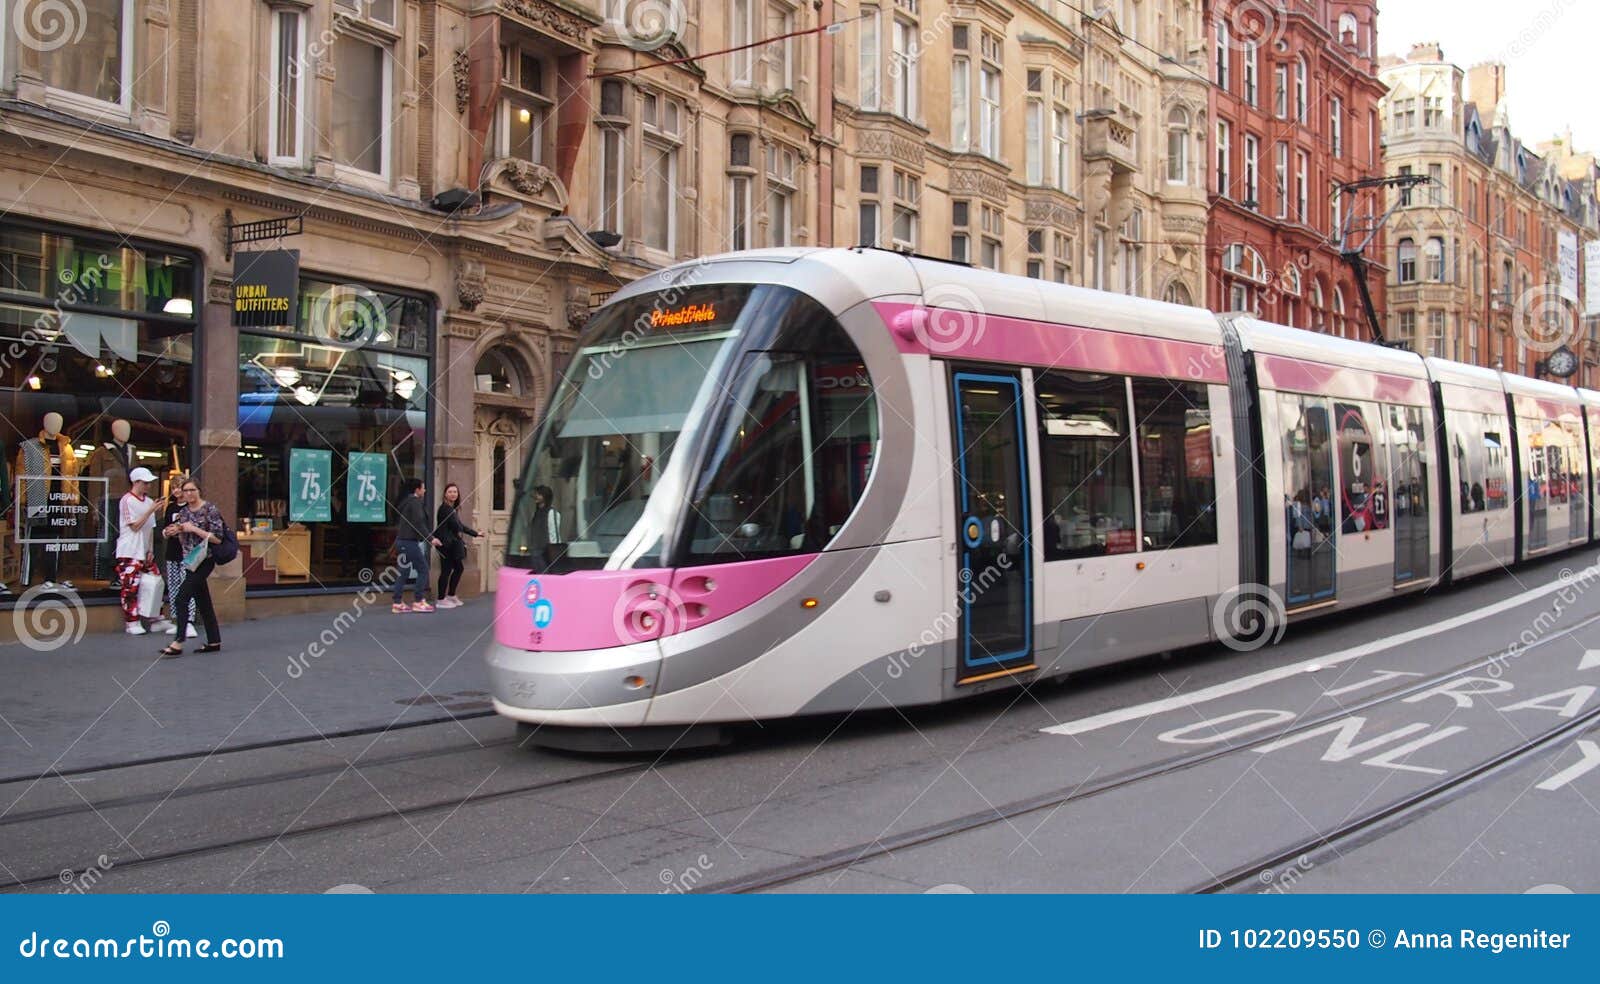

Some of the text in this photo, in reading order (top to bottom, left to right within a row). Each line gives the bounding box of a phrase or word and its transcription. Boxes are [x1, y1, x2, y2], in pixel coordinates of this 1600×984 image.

[236, 284, 268, 298] URBAN
[235, 297, 289, 312] OUTFITTERS
[49, 493, 79, 501] URBAN
[39, 505, 89, 514] OUTFITTERS
[45, 543, 60, 552] FIRST
[61, 543, 80, 552] FLOOR
